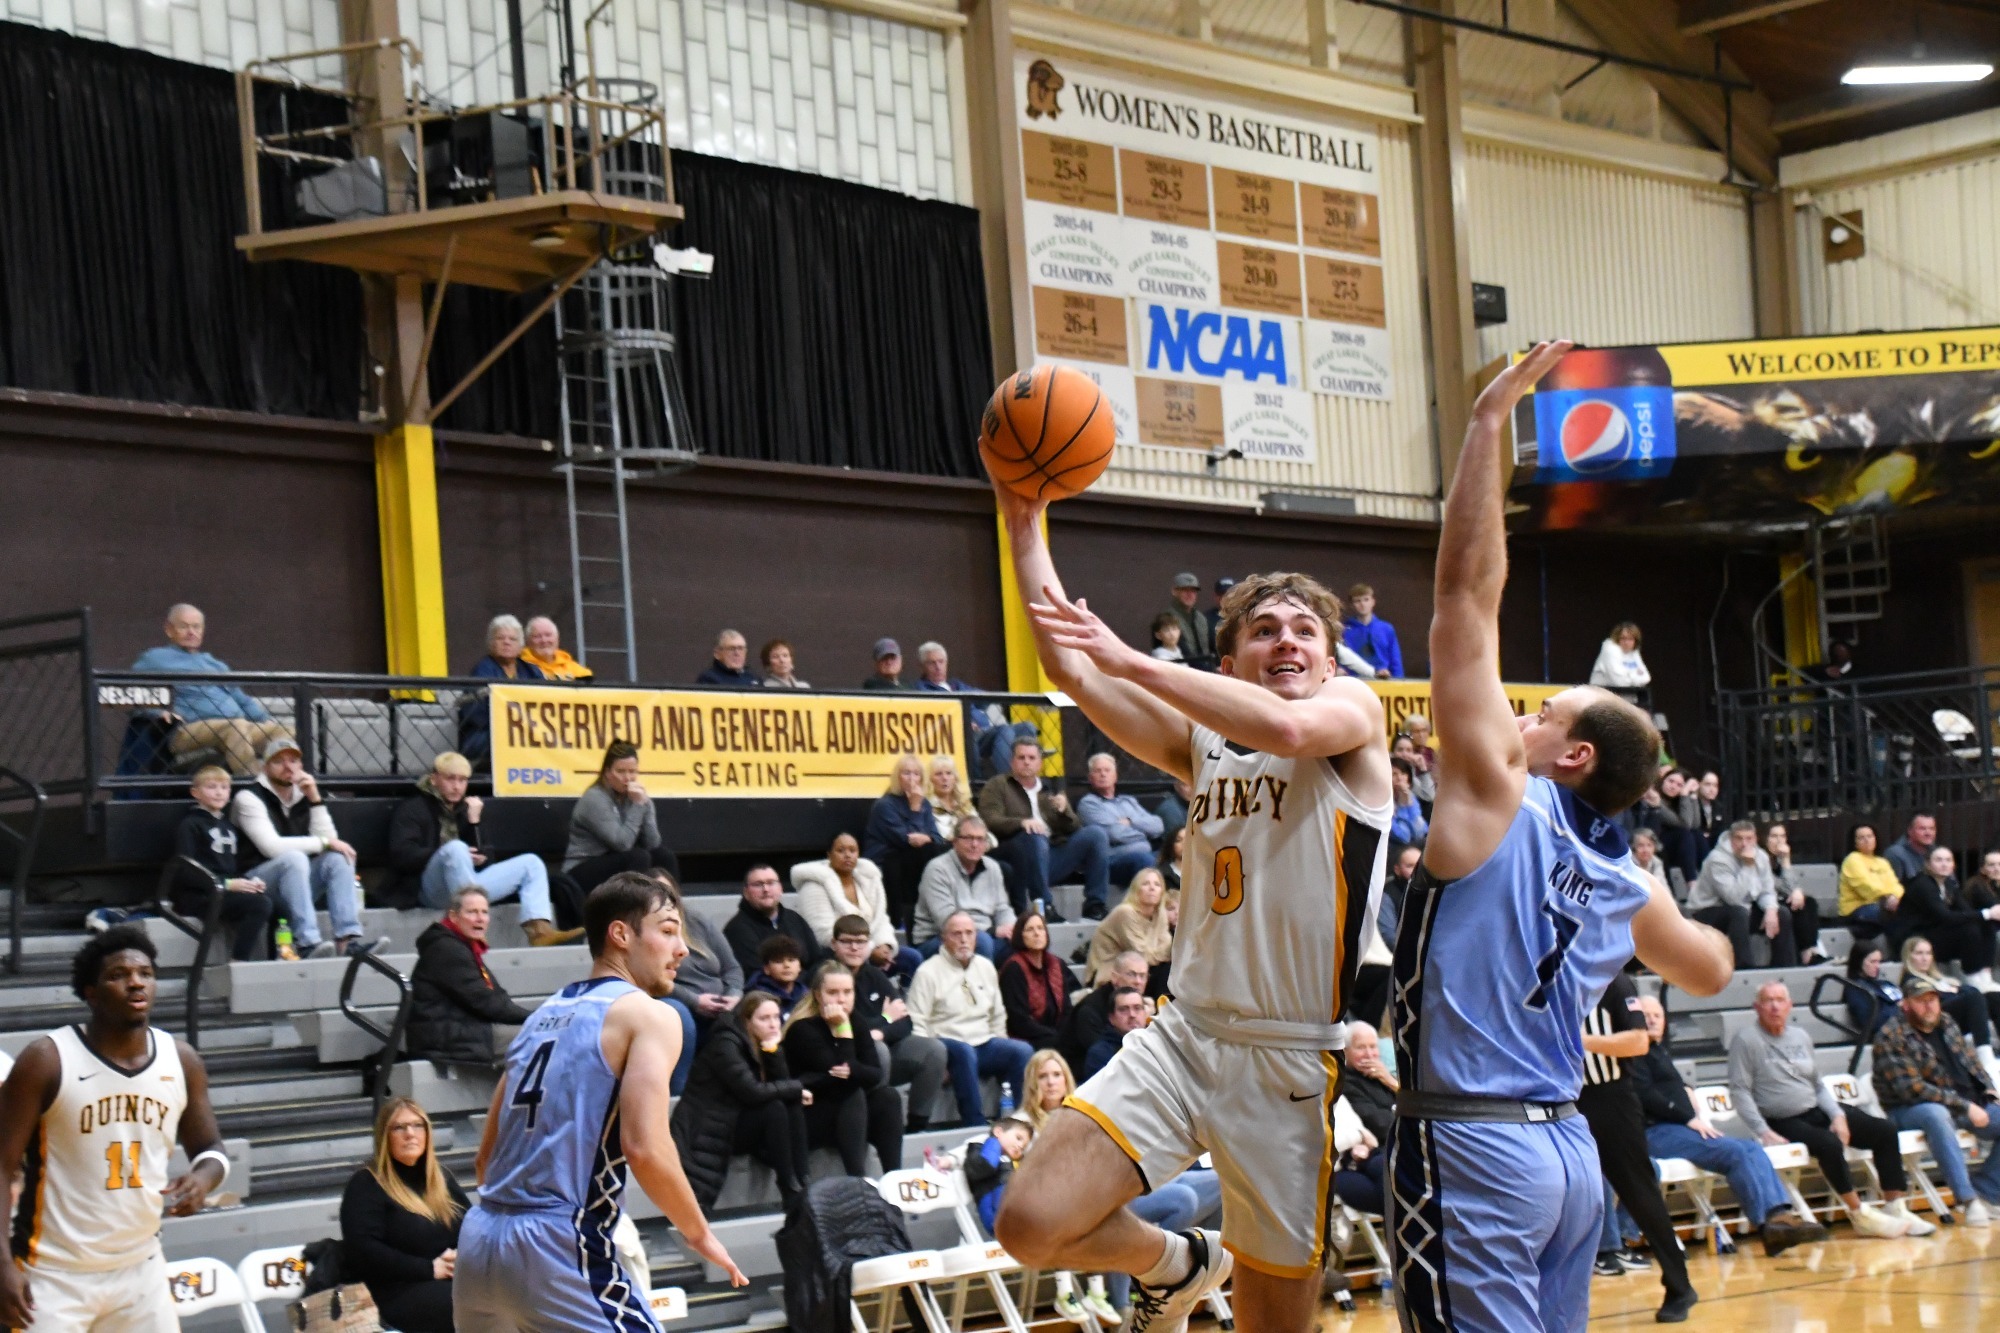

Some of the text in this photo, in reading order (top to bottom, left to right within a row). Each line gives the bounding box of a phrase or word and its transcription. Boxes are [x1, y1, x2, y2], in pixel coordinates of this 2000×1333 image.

[1072, 83, 1373, 173] WOMEN'S BASKETBALL
[1053, 158, 1088, 183] 25-8
[1150, 177, 1182, 202] 29-5
[1040, 263, 1113, 287] CHAMPIONS
[1138, 277, 1207, 301] CHAMPIONS
[1332, 280, 1359, 301] 27-5
[1064, 312, 1097, 336] 26-4
[1146, 305, 1288, 386] NCAA
[1728, 349, 1881, 376] WELCOME
[1889, 347, 1930, 368] TO
[1320, 375, 1382, 396] CHAMPIONS
[1164, 400, 1196, 423] 22-8
[1239, 439, 1304, 458] CHAMPIONS
[1633, 402, 1656, 467] pepsi
[506, 701, 955, 755] RESERVED AND GENERAL ADMISSION
[507, 762, 798, 787] PEPSI SEATING
[1211, 846, 1246, 915] 0
[1547, 860, 1594, 907] KING
[1523, 892, 1584, 1013] 7
[509, 1037, 559, 1132] 4
[80, 1094, 169, 1134] QUINCY
[105, 1141, 143, 1190] 11
